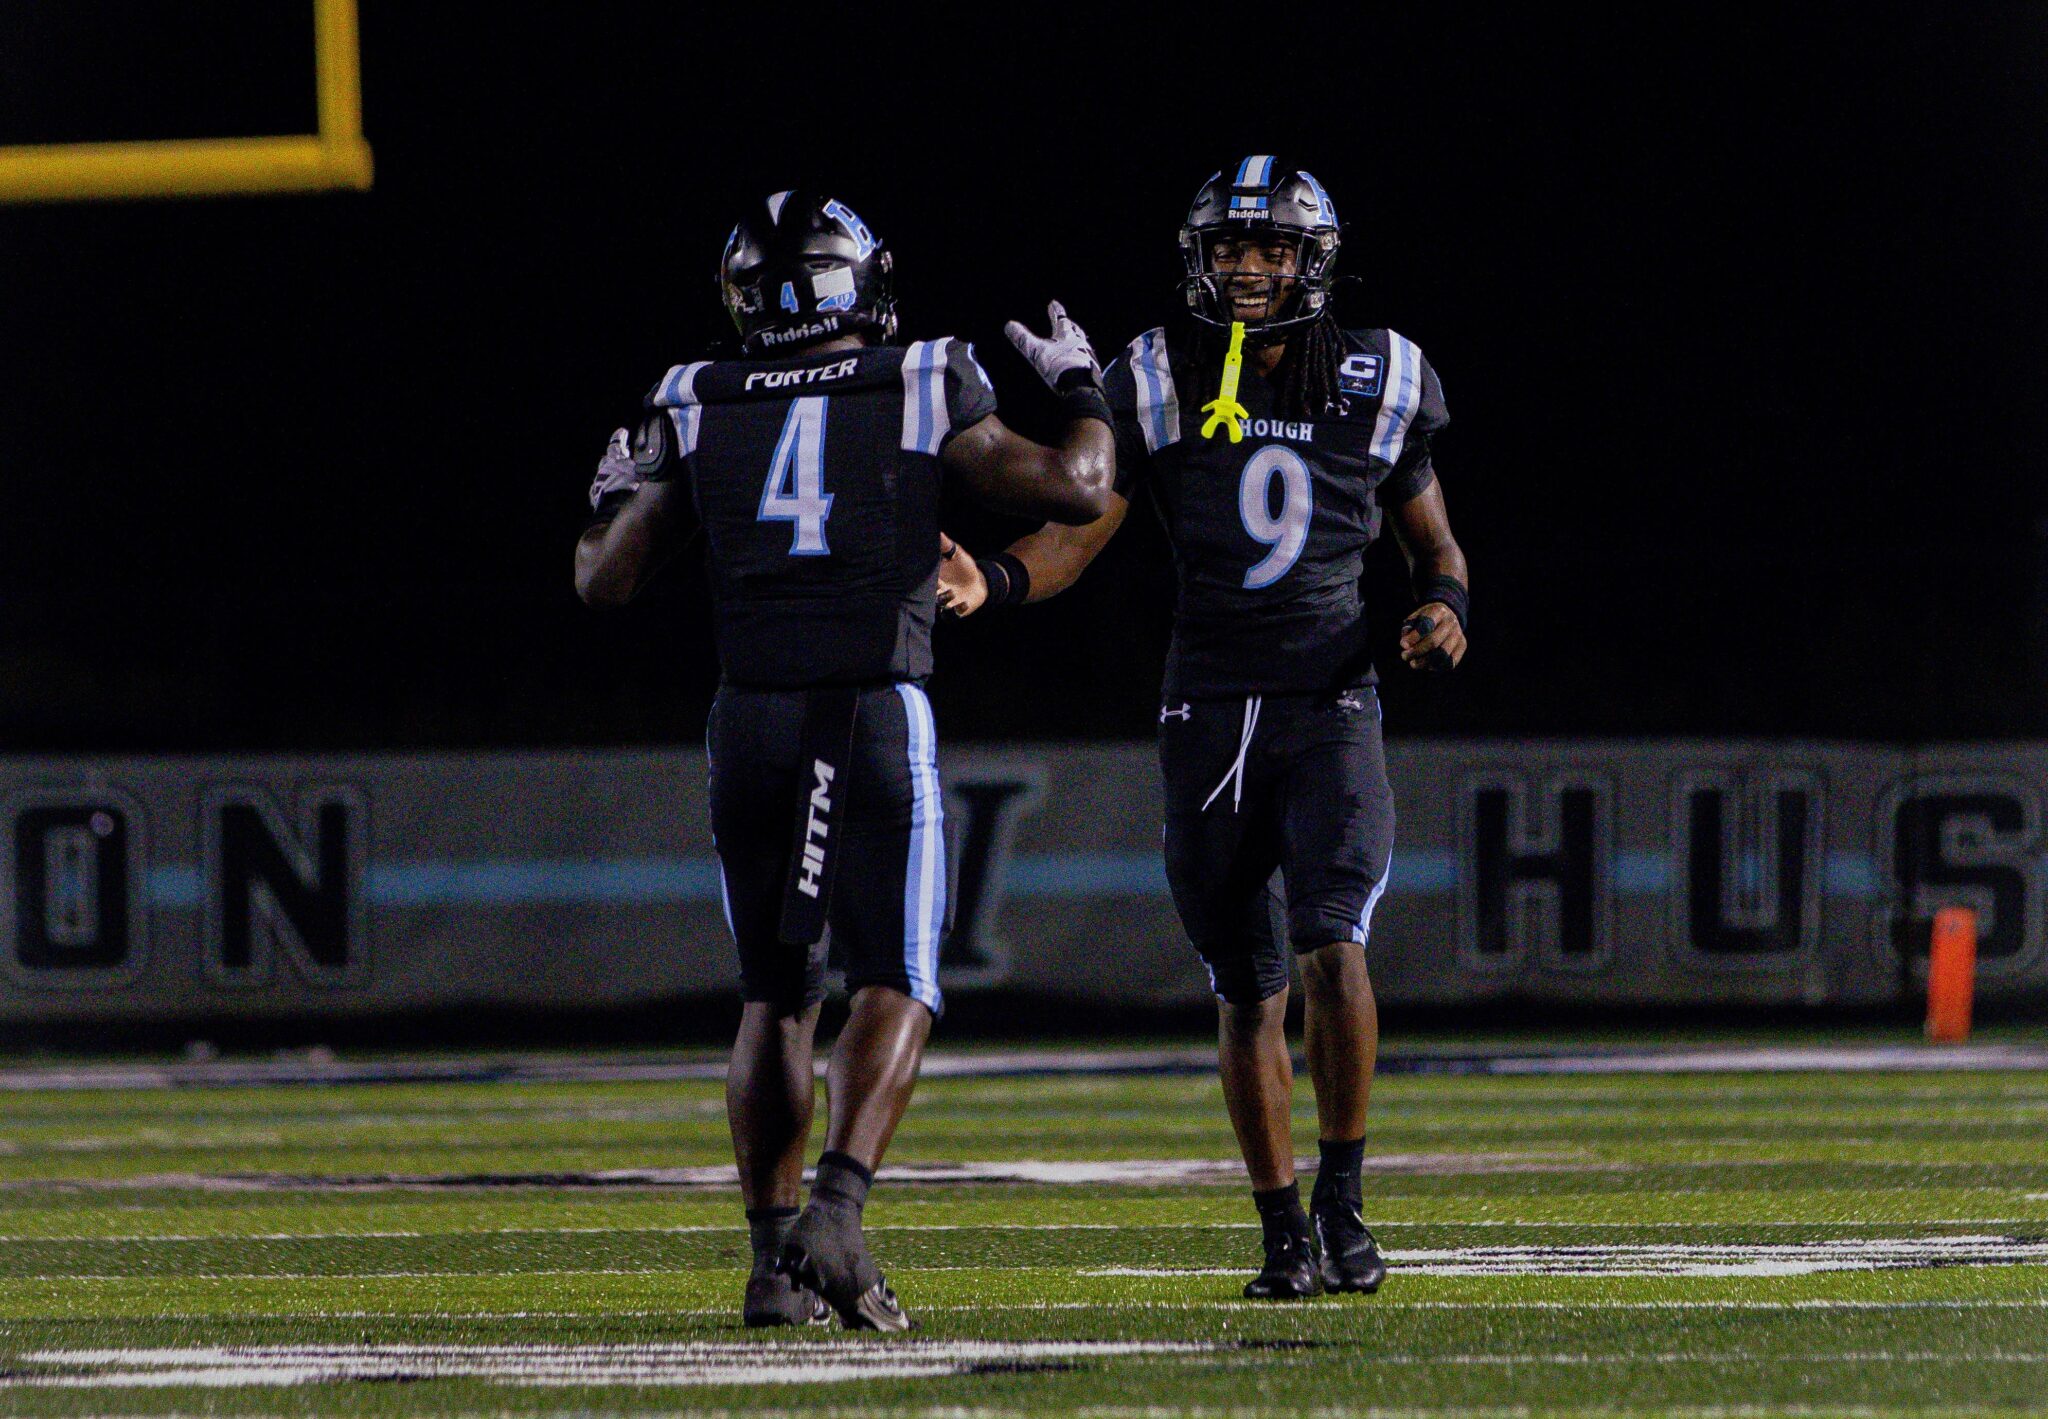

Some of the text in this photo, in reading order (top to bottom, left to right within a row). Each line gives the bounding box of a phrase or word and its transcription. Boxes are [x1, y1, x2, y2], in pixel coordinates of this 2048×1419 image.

[1228, 209, 1269, 220] Riddell
[780, 281, 799, 314] 4
[745, 358, 858, 391] PORTER
[1340, 356, 1377, 379] C
[1238, 418, 1314, 442] HOUGH
[757, 395, 835, 556] 4
[1238, 444, 1313, 590] 9
[798, 758, 836, 899] HITM
[12, 786, 2028, 968] ON HUS
